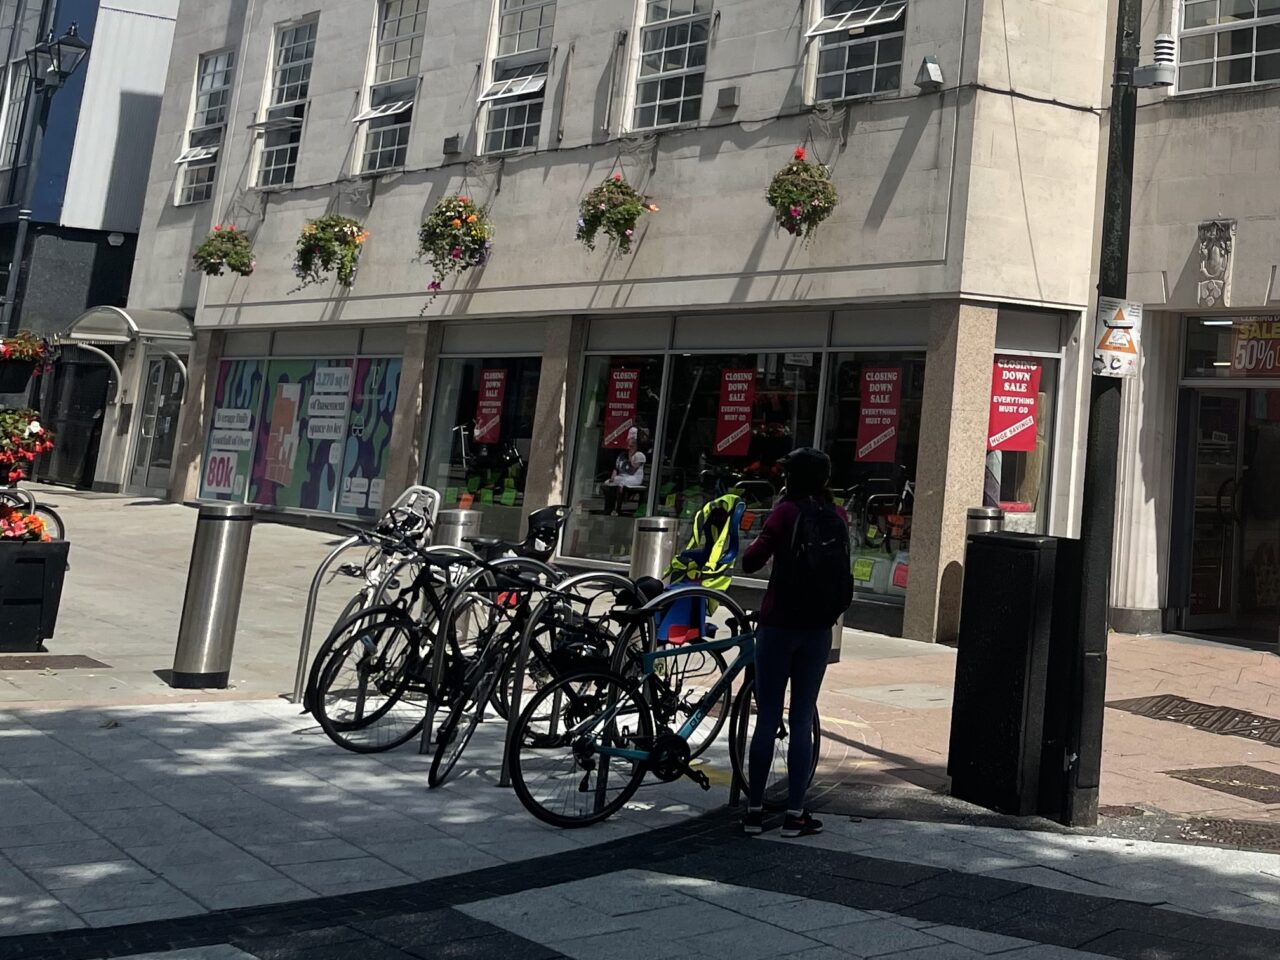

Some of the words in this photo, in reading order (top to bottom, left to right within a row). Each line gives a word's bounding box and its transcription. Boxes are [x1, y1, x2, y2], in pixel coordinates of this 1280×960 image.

[1235, 340, 1274, 369] 50%
[997, 359, 1037, 371] CLOSING
[612, 371, 637, 380] CLOSING
[725, 372, 752, 381] CLOSING
[865, 372, 897, 381] CLOSING
[1002, 371, 1031, 381] DOWN
[727, 383, 748, 391] DOWN
[869, 383, 893, 392] DOWN
[1004, 382, 1028, 392] SALE
[728, 393, 746, 402] SALE
[870, 394, 890, 403] SALE
[993, 395, 1035, 405] EVERYTHING
[861, 408, 897, 416] EVERYTHING
[998, 405, 1018, 414] MUST
[1018, 406, 1029, 414] GO
[865, 417, 881, 425] MUST
[882, 417, 891, 425] GO
[991, 431, 1008, 445] HUGE
[1008, 418, 1033, 437] SAVINGS
[207, 456, 233, 487] 80k
